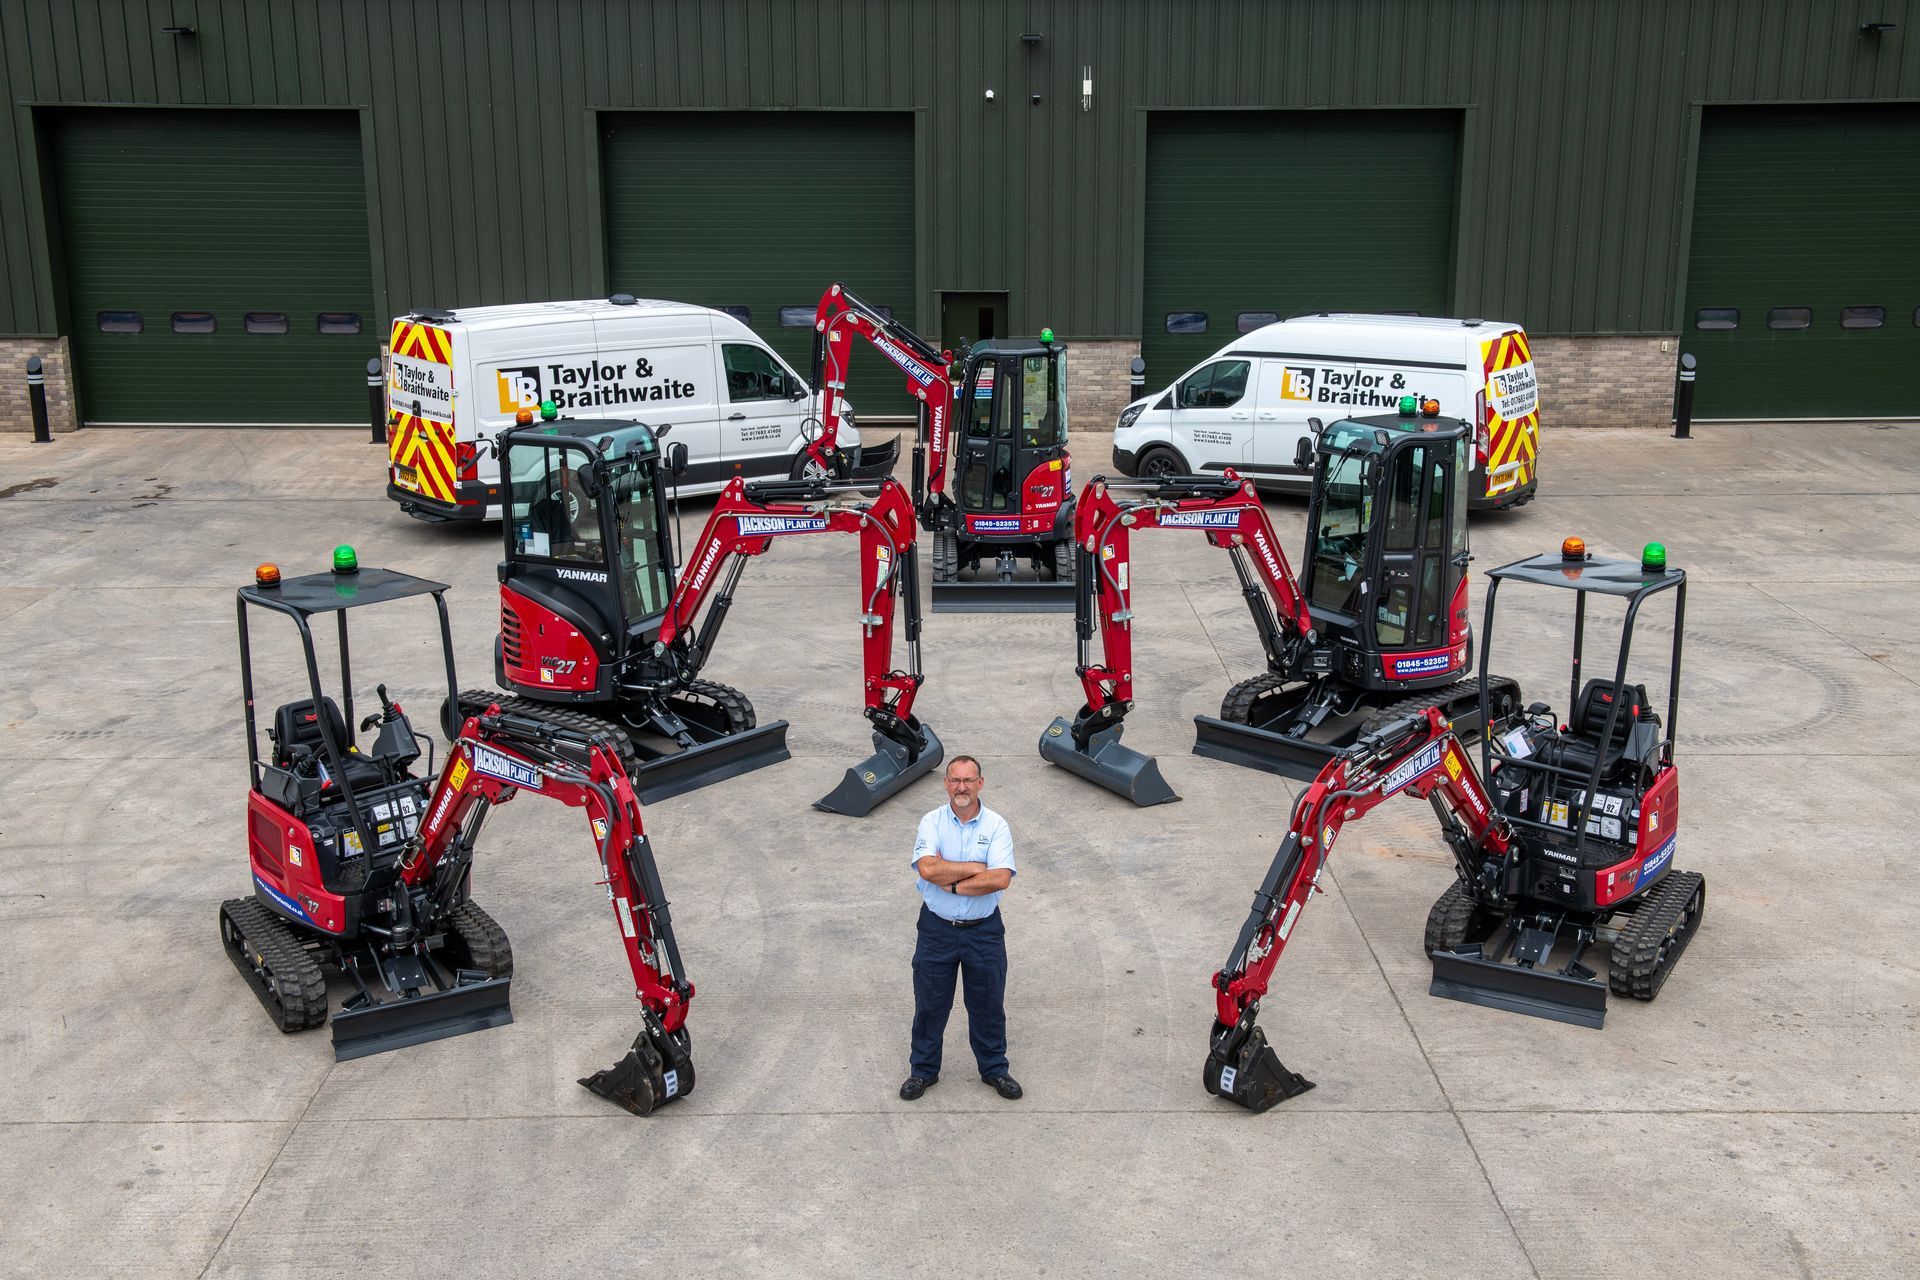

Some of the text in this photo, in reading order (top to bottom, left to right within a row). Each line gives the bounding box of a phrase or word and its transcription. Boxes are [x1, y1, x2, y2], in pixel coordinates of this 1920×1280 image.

[873, 336, 934, 386] JACKSON PLANT Ltd
[403, 364, 435, 383] Taylor &
[547, 357, 654, 389] Taylor &
[1321, 368, 1406, 390] Taylor &
[1507, 370, 1524, 384] Taylor
[403, 379, 450, 401] Braithwaite
[549, 378, 696, 409] Braithwaite
[1508, 377, 1536, 395] Braithwaite
[1501, 399, 1510, 408] Tel:
[933, 405, 943, 453] YANMAR
[1035, 501, 1057, 509] YANMAR
[739, 516, 826, 536] JACKSON PLANT Ltd
[1160, 511, 1239, 526] JACKSON PLANT Ltd
[691, 537, 722, 591] YANMAR
[1253, 529, 1283, 581] YANMAR
[556, 568, 608, 583] YANMAR
[1396, 655, 1449, 669] 01845-523574
[473, 746, 511, 776] JACKSON
[510, 763, 530, 783] PLANT
[1386, 759, 1416, 791] ACKSON
[1415, 751, 1432, 772] PLANT
[1460, 776, 1485, 815] YANMAR
[402, 804, 411, 814] 92
[428, 787, 454, 832] YANMAR
[1605, 803, 1615, 813] 92
[1543, 849, 1577, 863] YANMAR
